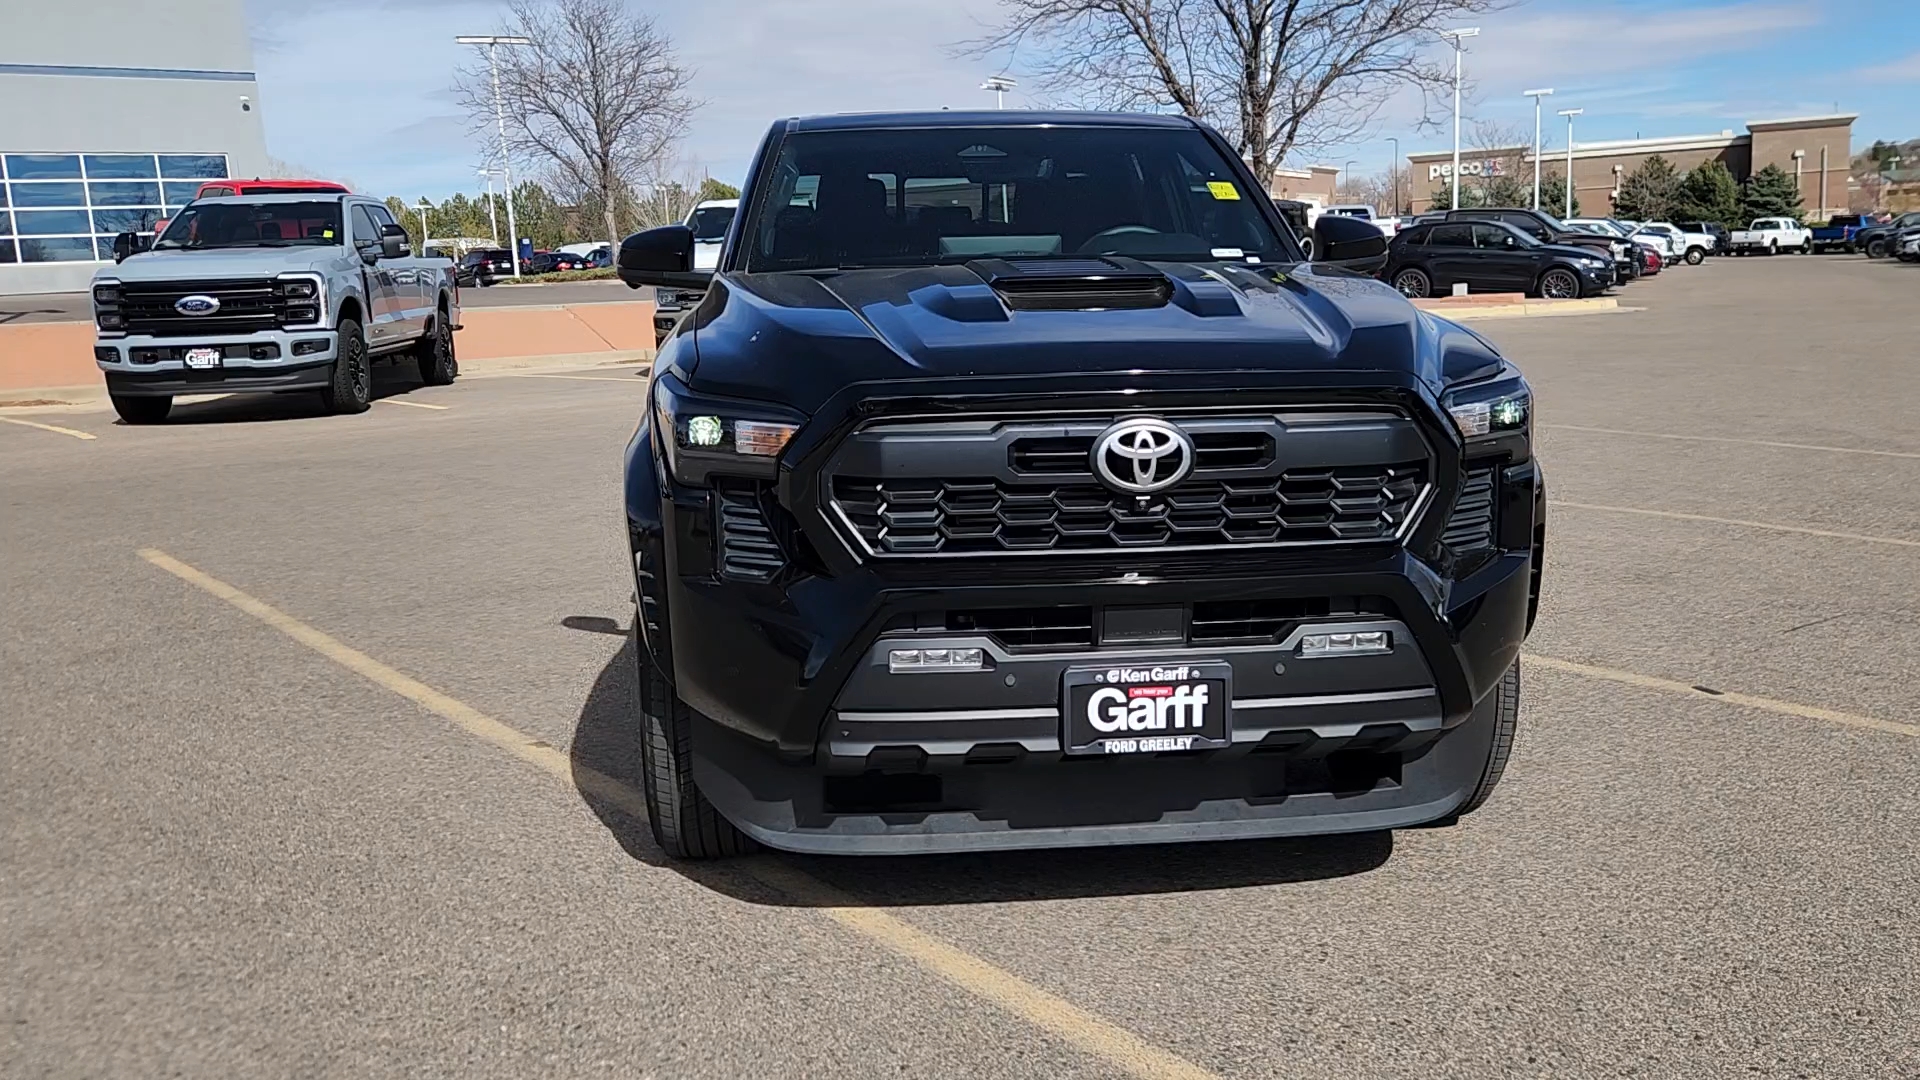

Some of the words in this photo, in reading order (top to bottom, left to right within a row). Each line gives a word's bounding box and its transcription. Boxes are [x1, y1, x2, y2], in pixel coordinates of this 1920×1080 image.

[1429, 160, 1481, 180] peco
[185, 352, 220, 366] Garff
[1121, 669, 1150, 683] Ken
[1151, 667, 1189, 682] Garff
[1087, 684, 1209, 733] Garff
[1105, 740, 1137, 754] FORD
[1139, 738, 1193, 752] GREELEY
